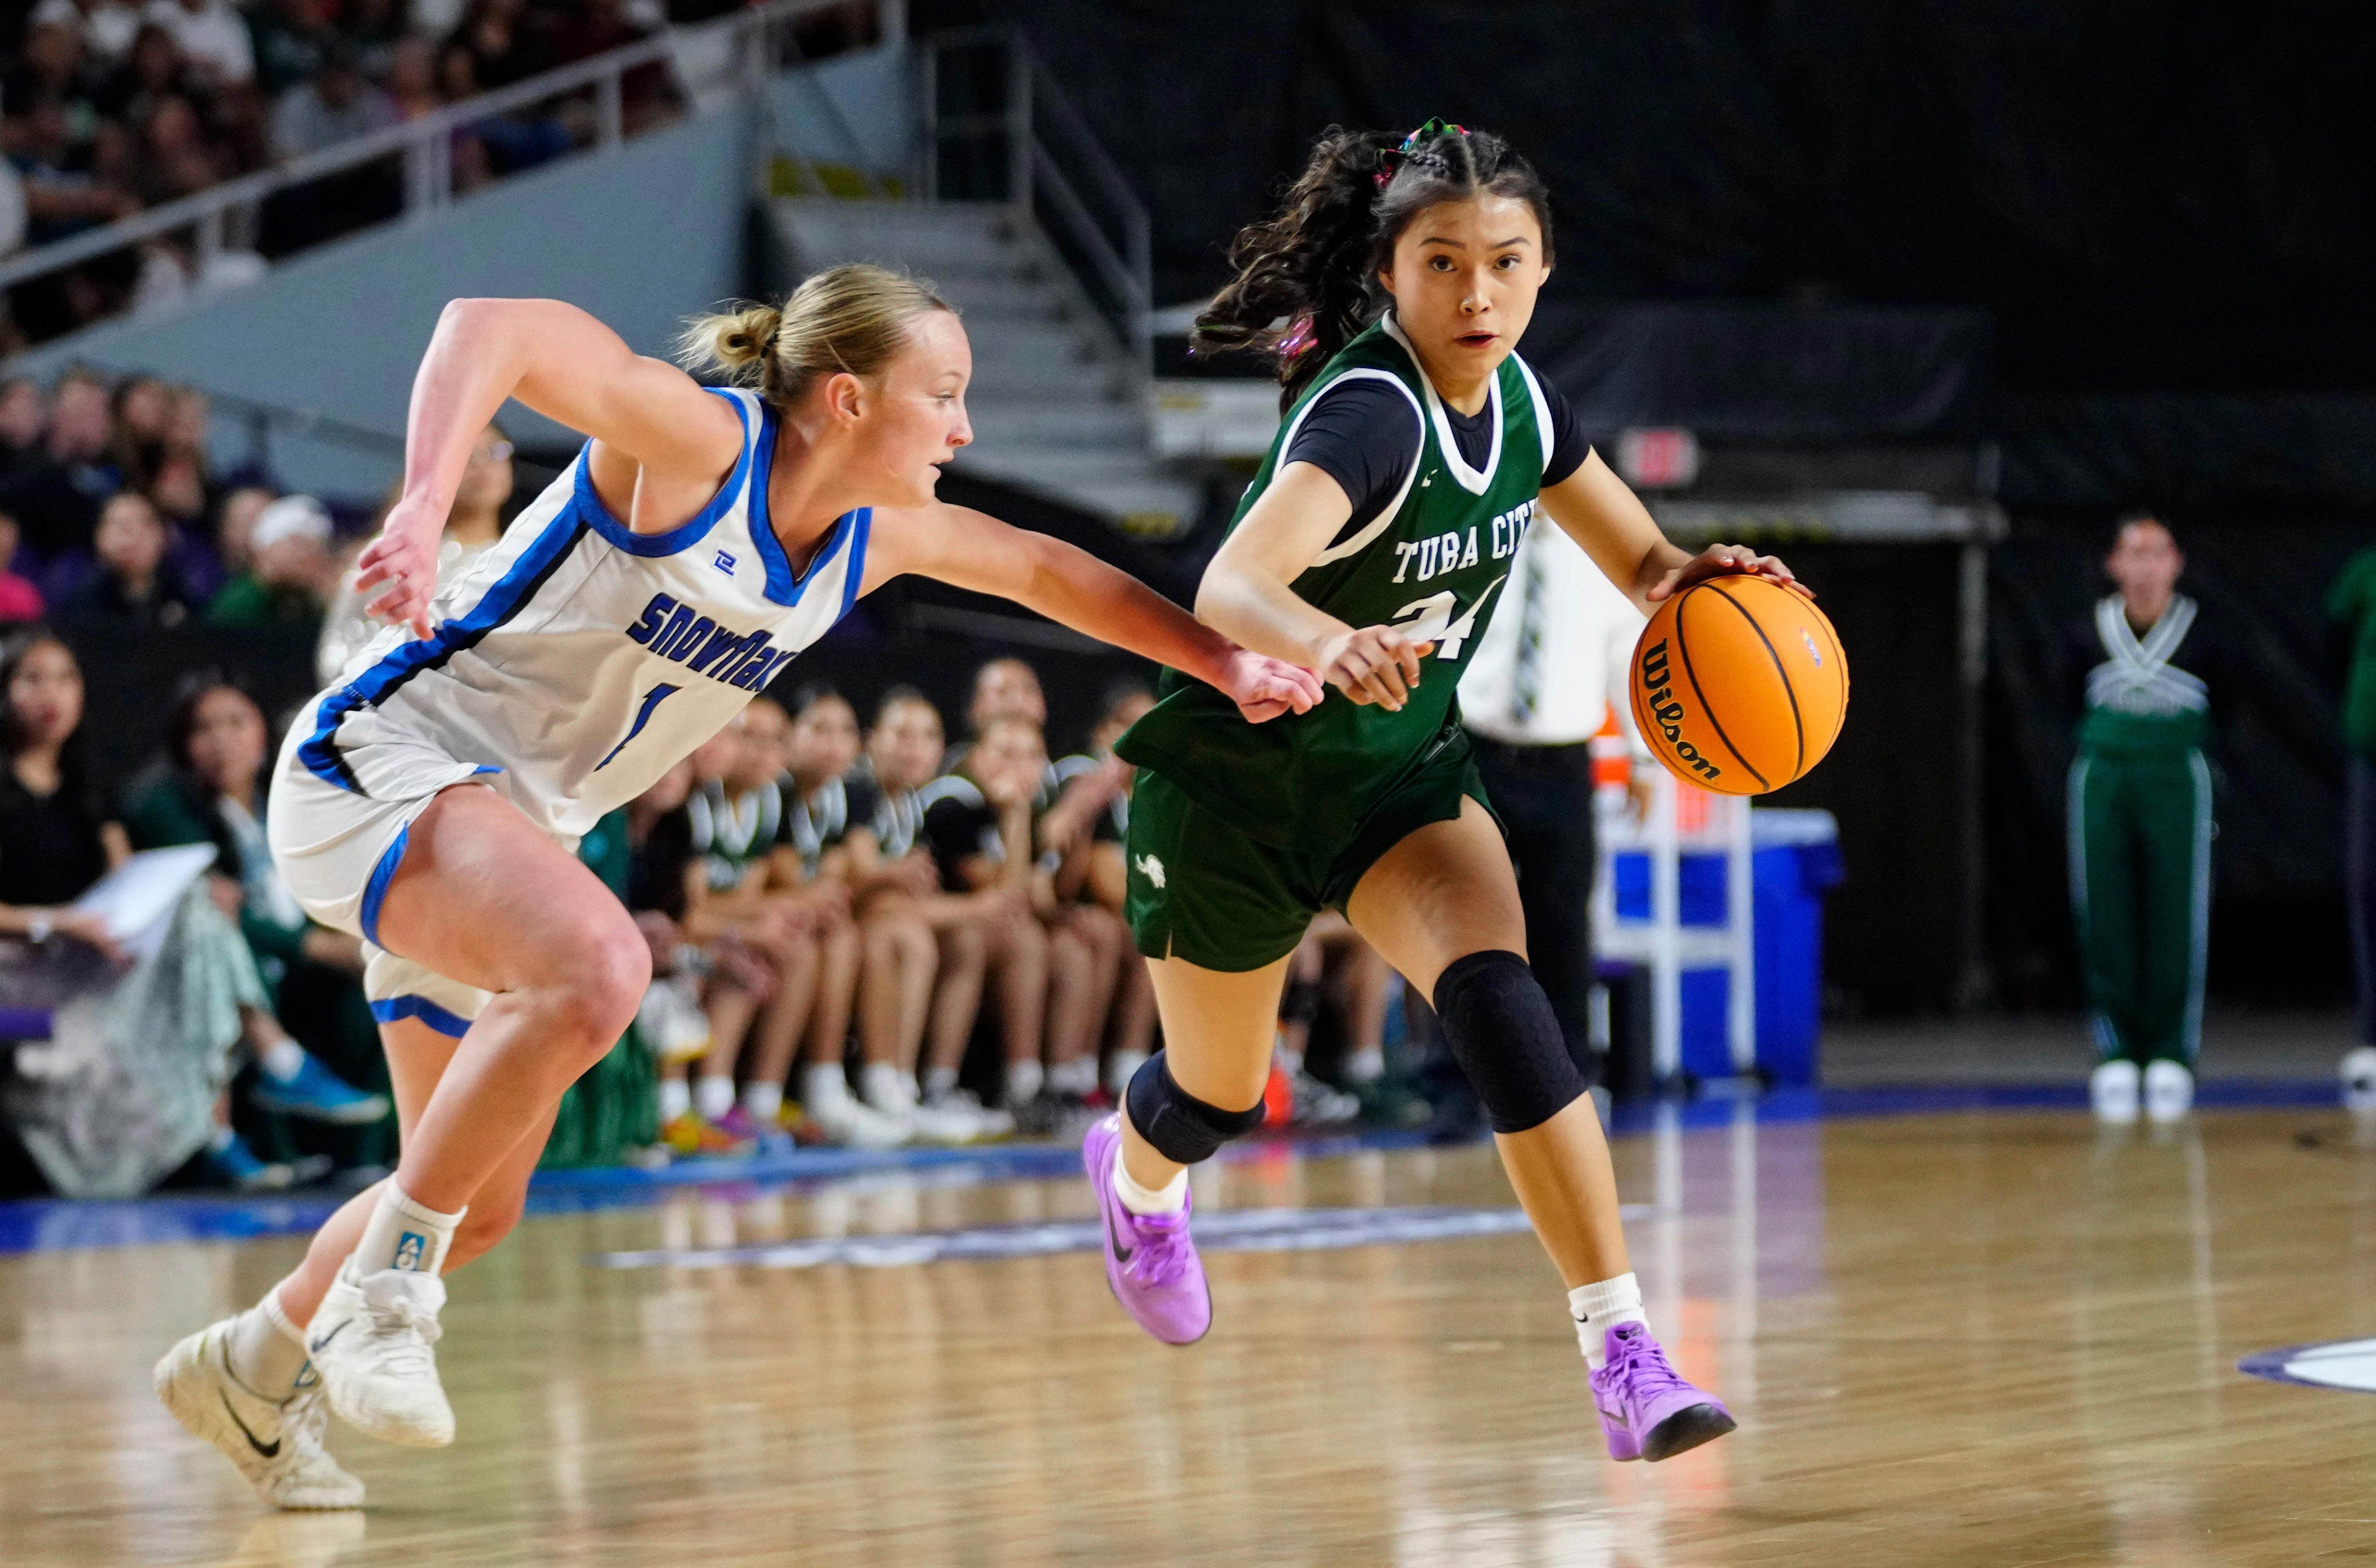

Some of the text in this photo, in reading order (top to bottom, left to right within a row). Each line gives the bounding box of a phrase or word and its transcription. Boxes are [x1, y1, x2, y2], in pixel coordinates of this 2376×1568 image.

[1391, 526, 1479, 583] TUBA
[1390, 574, 1507, 659] 24
[593, 682, 684, 772] 1
[1642, 637, 1722, 781] Wilson
